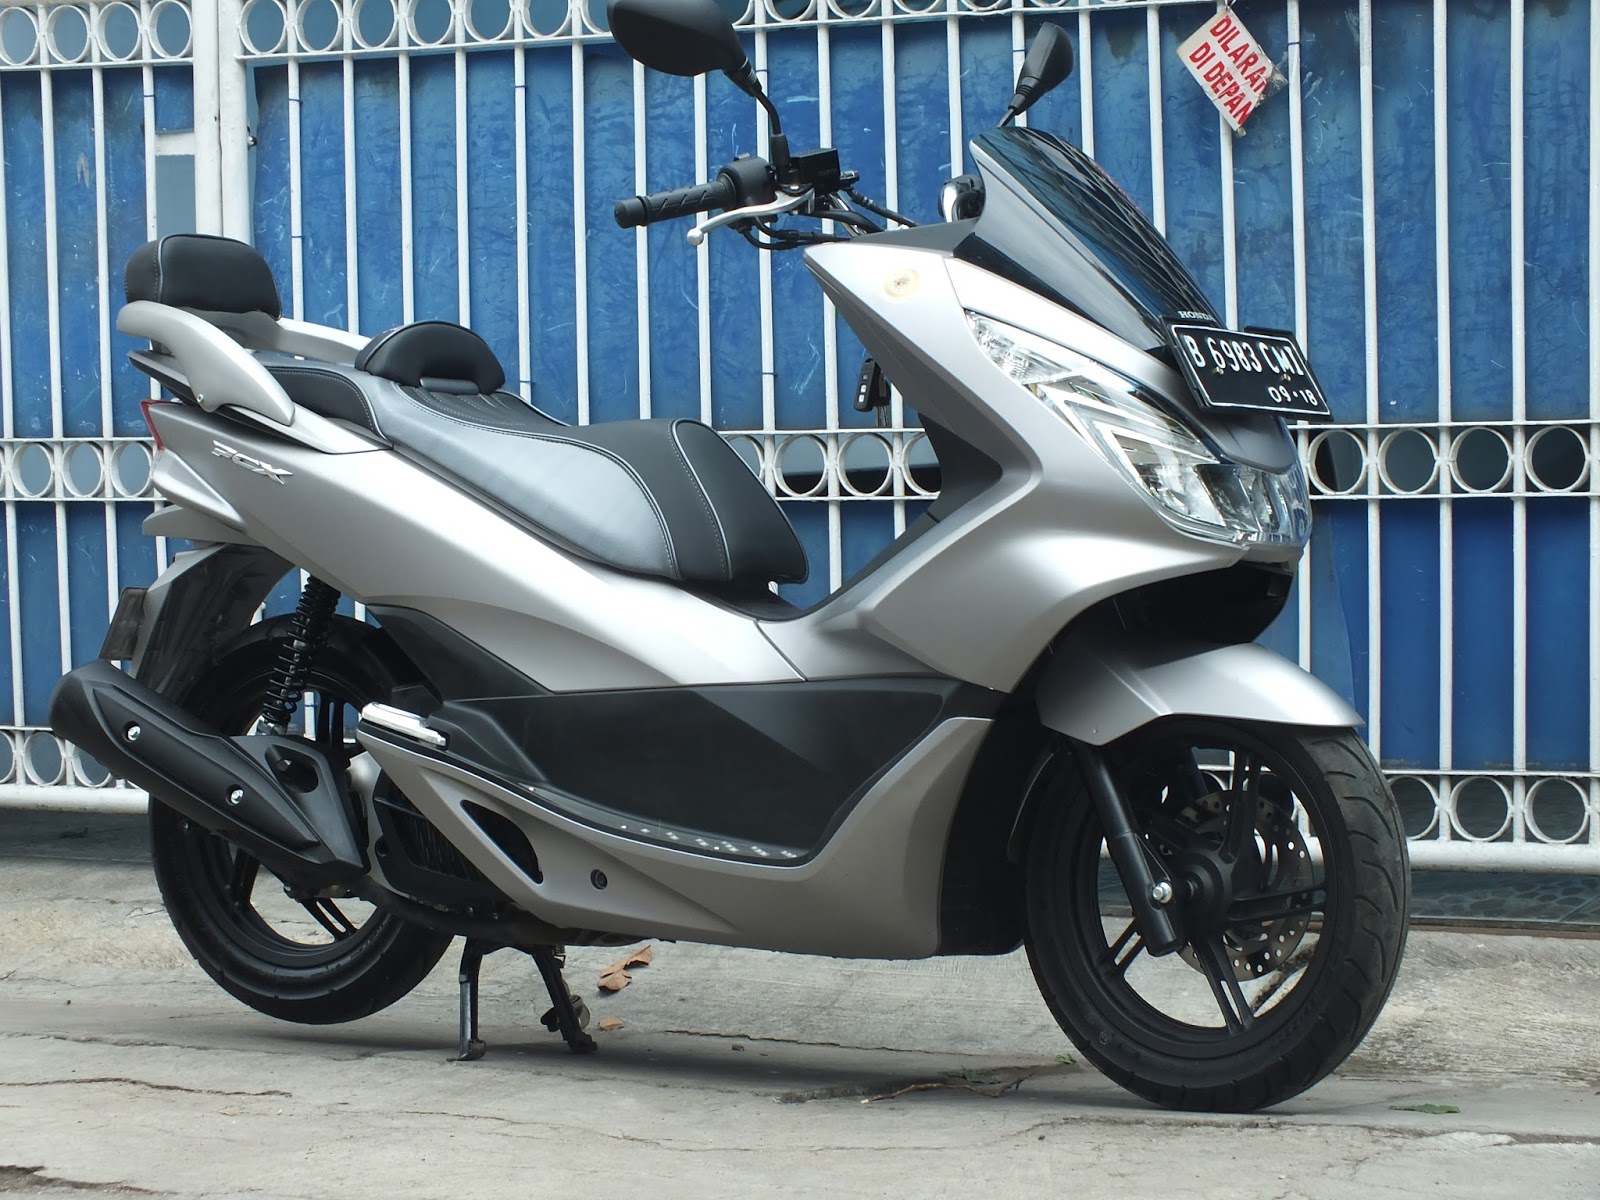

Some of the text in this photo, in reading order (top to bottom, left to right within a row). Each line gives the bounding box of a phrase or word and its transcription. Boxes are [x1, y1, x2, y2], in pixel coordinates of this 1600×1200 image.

[1189, 42, 1252, 125] DI DEPAN
[1177, 310, 1217, 323] HONDA
[1183, 334, 1206, 368] B
[1207, 336, 1263, 373] 6983
[211, 439, 293, 485] PCX
